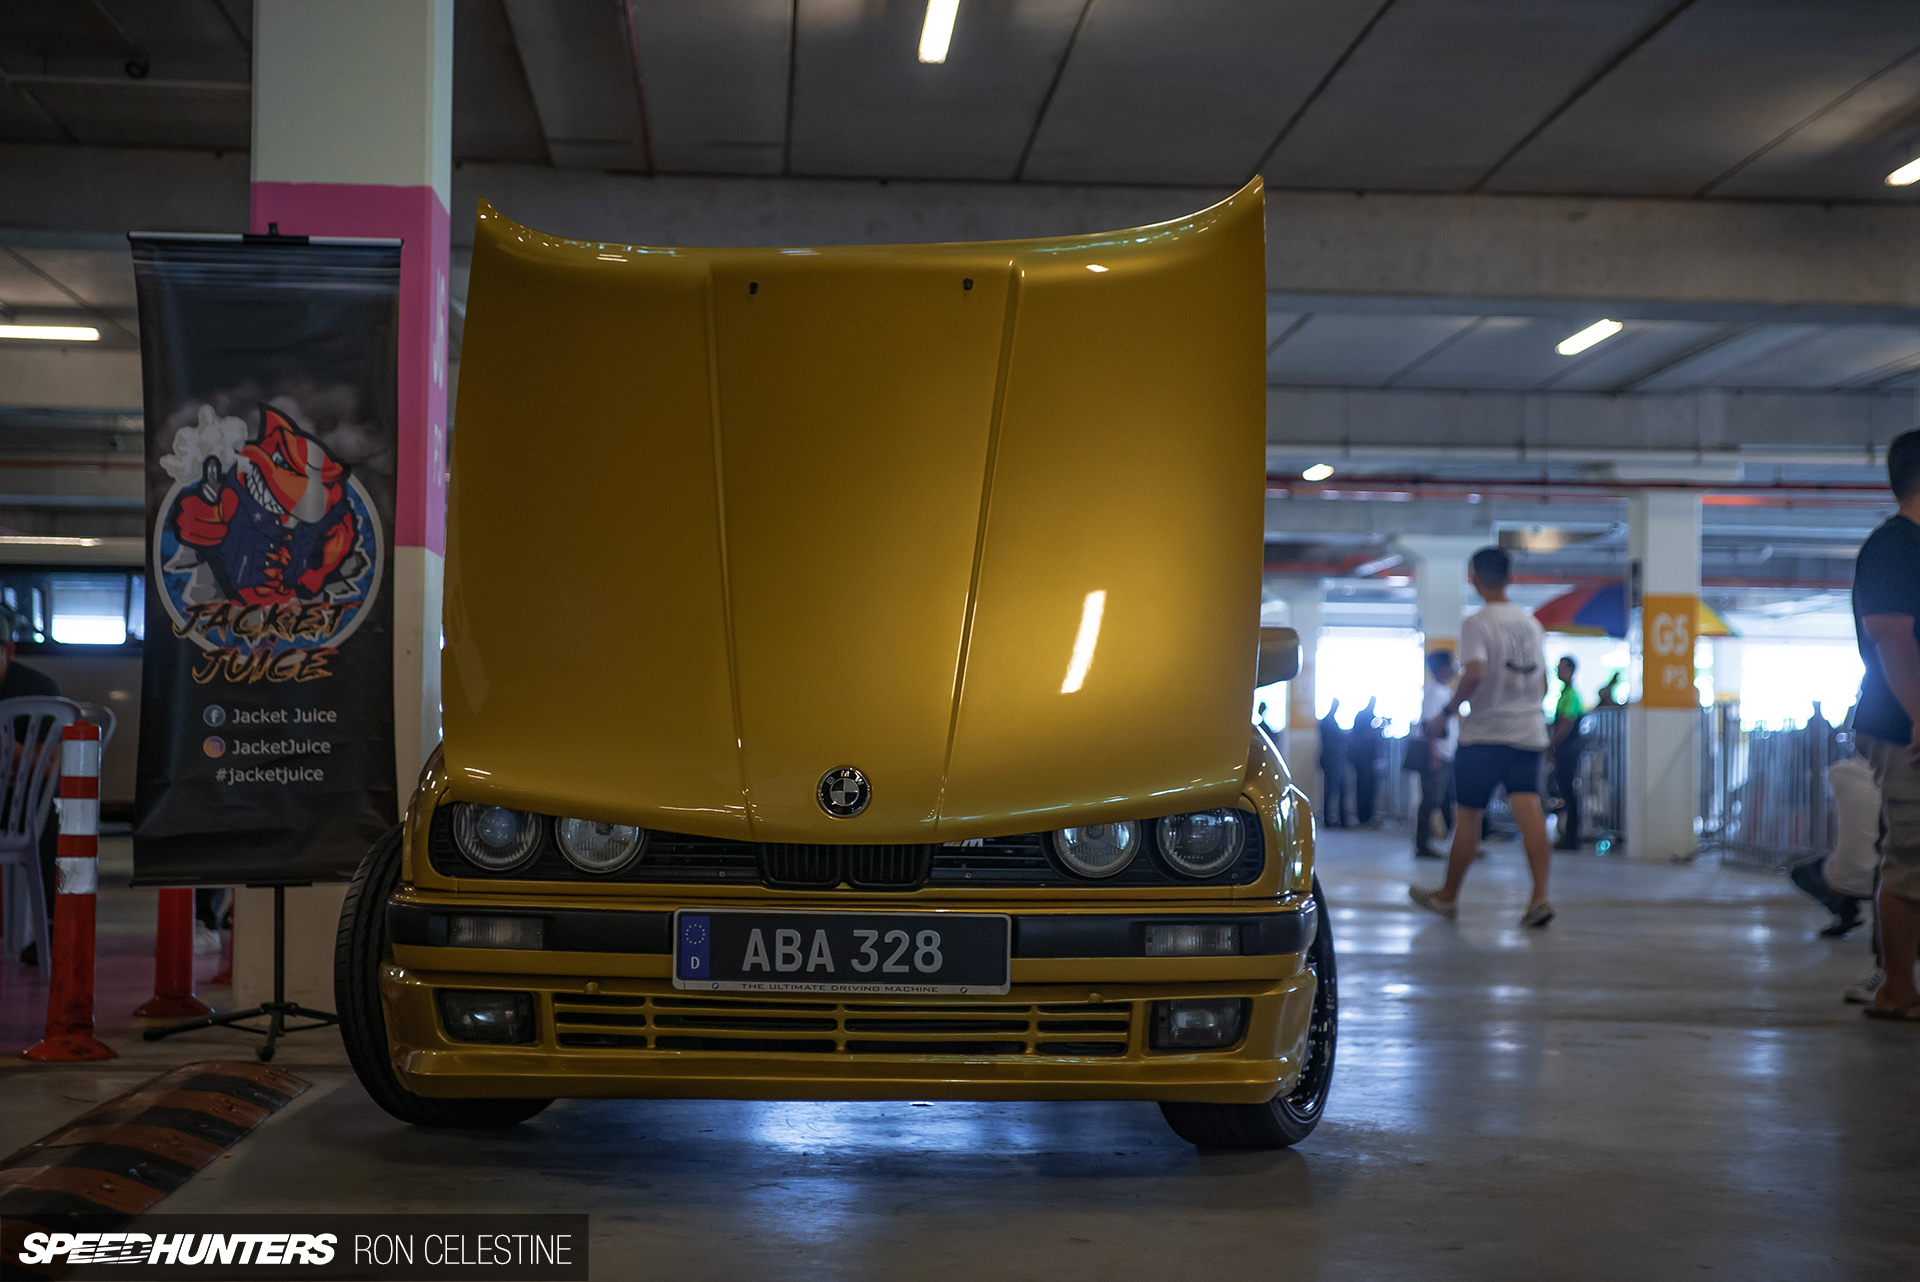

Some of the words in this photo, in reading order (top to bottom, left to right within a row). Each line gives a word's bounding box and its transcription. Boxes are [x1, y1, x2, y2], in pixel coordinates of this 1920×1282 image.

[172, 602, 362, 642] JACKET
[1652, 612, 1690, 656] G5
[192, 646, 340, 684] JUICE
[232, 708, 288, 724] Jacket
[293, 708, 337, 723] Juice
[231, 739, 332, 755] JacketJuice
[215, 766, 324, 785] #jacketjuice
[691, 956, 700, 970] D
[741, 928, 835, 972] ABA
[850, 929, 943, 973] 328
